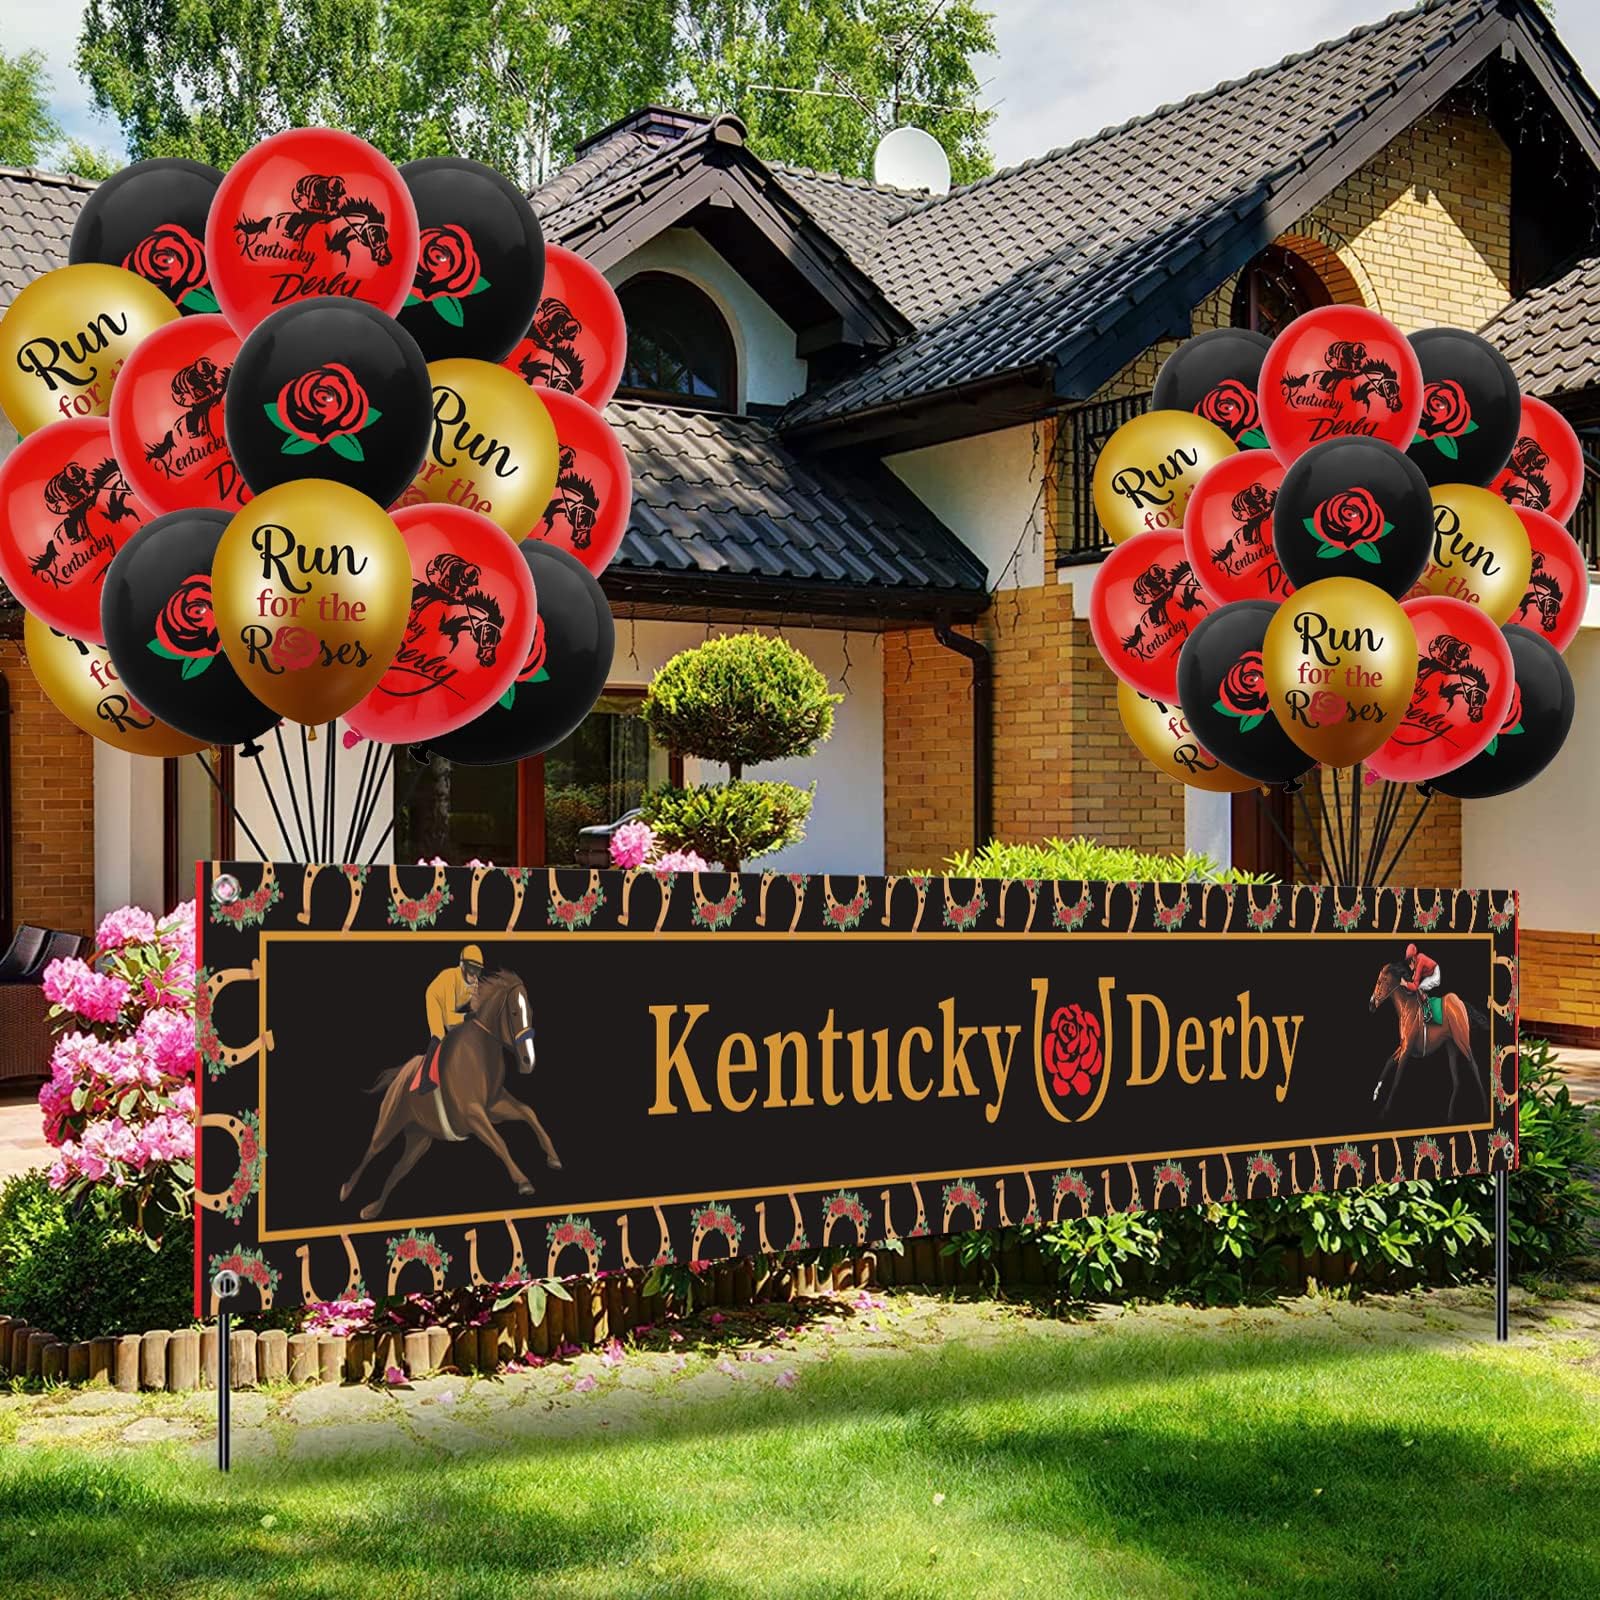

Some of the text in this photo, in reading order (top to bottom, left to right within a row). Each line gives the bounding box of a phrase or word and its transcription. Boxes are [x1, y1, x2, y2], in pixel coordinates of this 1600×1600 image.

[235, 233, 317, 272] Kentucky
[270, 271, 362, 305] Derby
[17, 311, 128, 391] Run
[58, 381, 104, 419] for
[1281, 385, 1345, 418] Kentucky
[430, 385, 519, 479] Run
[1307, 416, 1379, 443] Derby
[445, 477, 492, 513] the
[1112, 447, 1198, 509] Run
[1143, 501, 1178, 531] for
[251, 524, 368, 594] Run
[1434, 504, 1500, 576] Run
[41, 531, 116, 589] Kentucky
[257, 588, 367, 622] for the
[1444, 577, 1481, 604] the
[1131, 619, 1189, 662] Kentucky
[1294, 611, 1384, 667] Run
[394, 641, 459, 686] erby
[1297, 661, 1383, 688] for the
[1405, 702, 1455, 736] erby
[648, 990, 1304, 1123] Kentucky Derby
